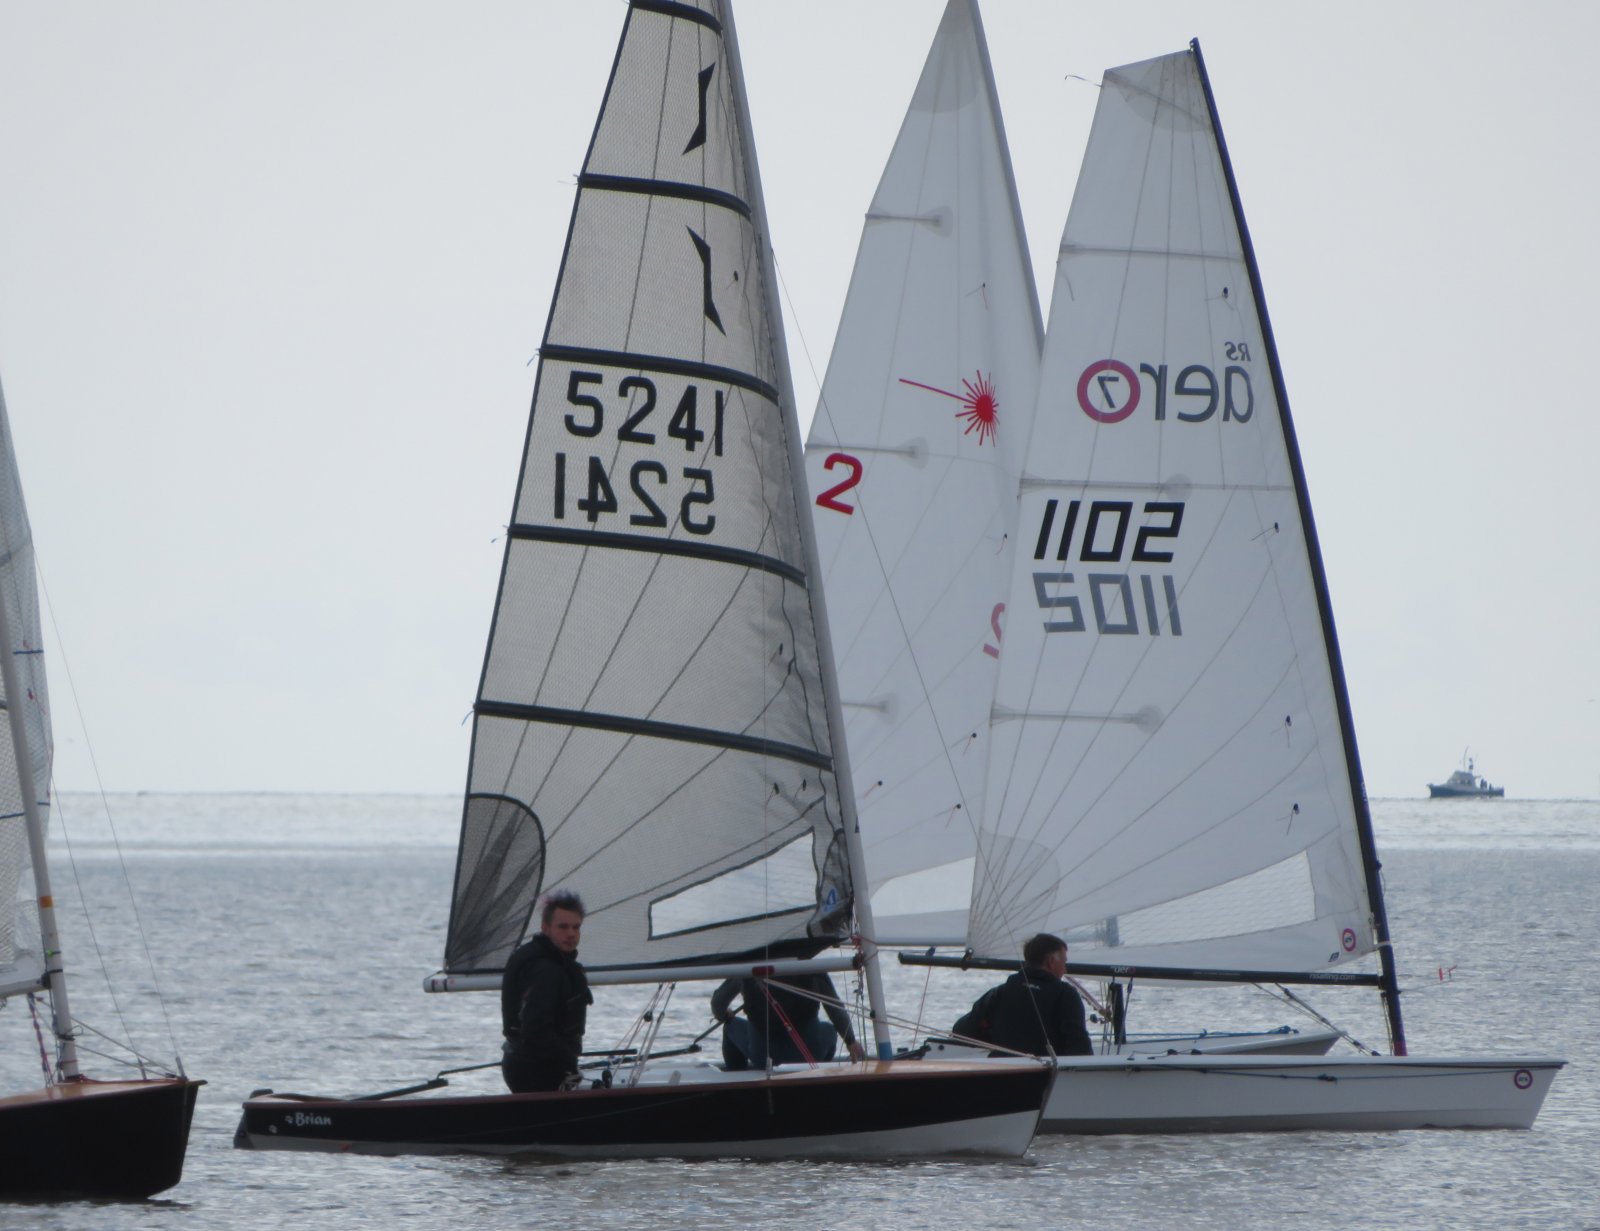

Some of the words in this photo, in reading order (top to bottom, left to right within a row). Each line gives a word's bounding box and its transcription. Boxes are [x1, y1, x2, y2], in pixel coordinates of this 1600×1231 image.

[564, 370, 723, 456] 5241
[816, 452, 863, 515] 2
[1034, 499, 1185, 563] 1102
[295, 1111, 332, 1127] Brian
